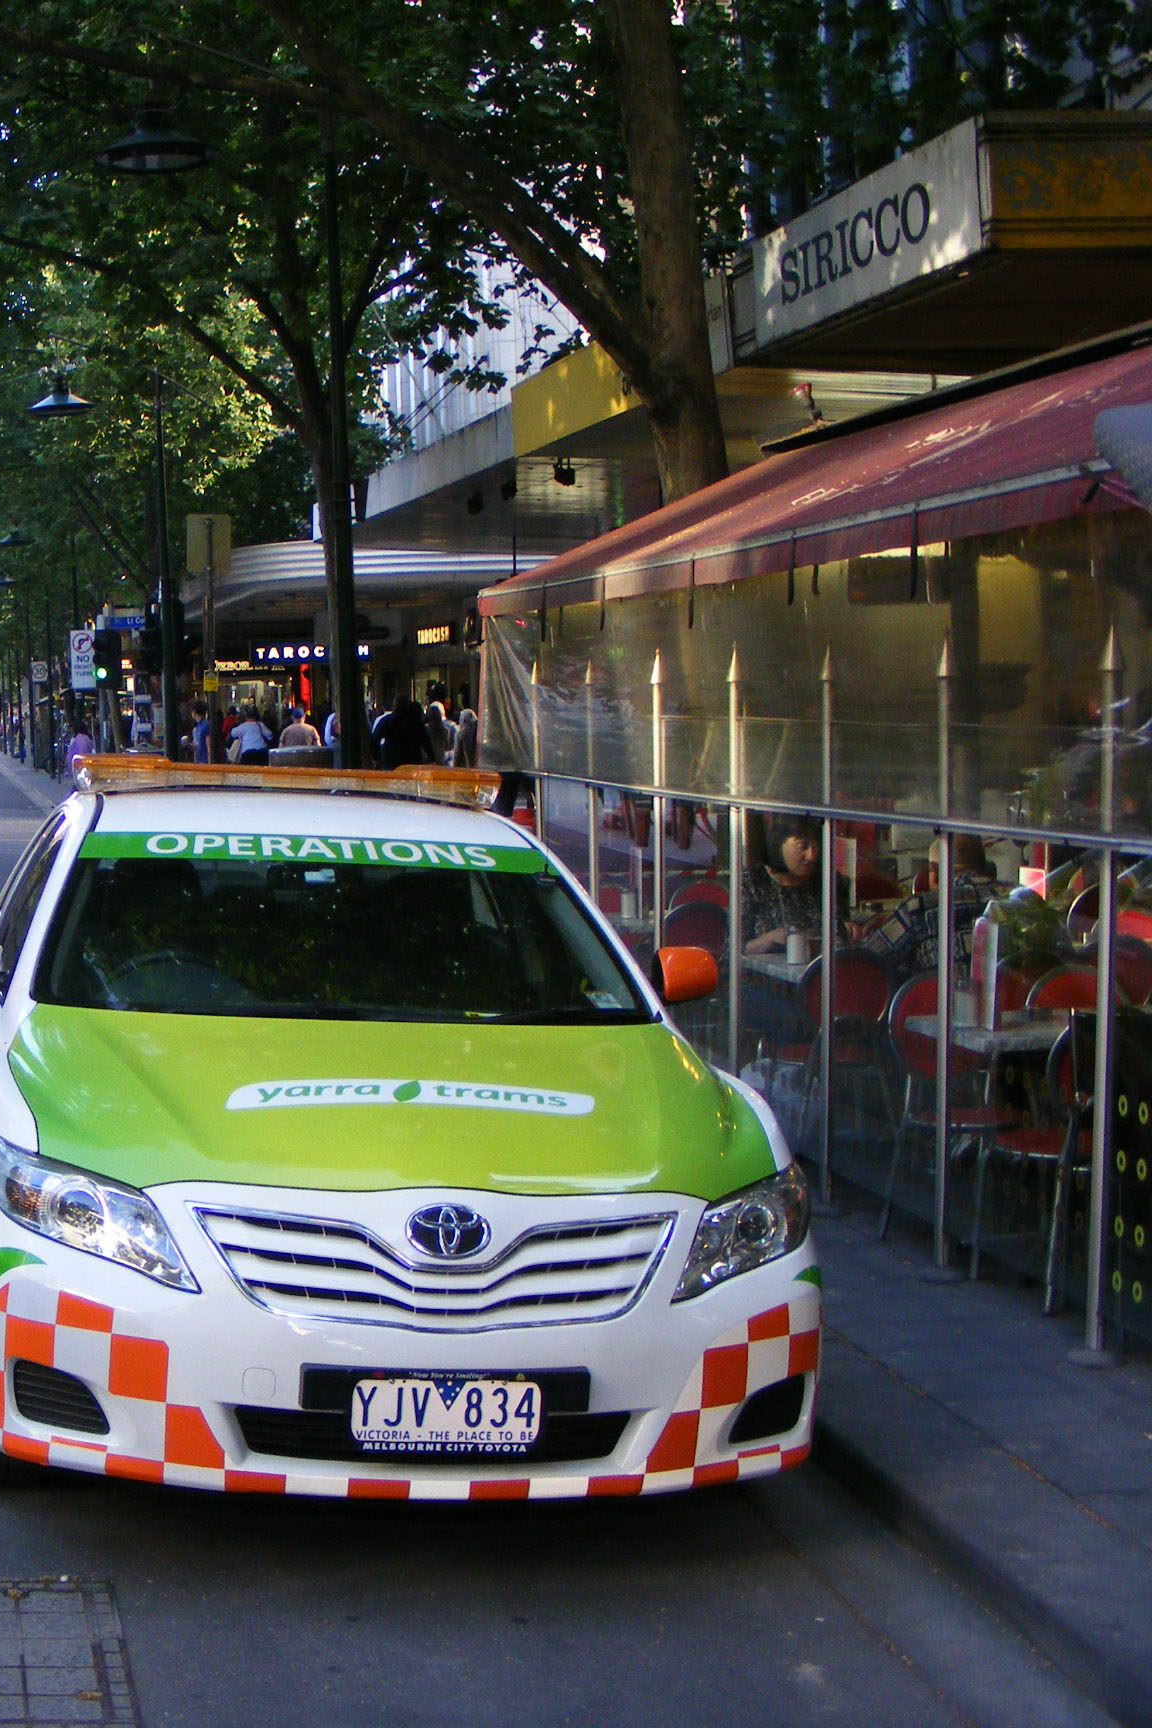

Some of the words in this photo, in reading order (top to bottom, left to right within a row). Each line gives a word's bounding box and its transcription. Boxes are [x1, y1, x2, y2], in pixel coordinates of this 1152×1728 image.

[780, 182, 930, 306] SIRICCO
[76, 655, 90, 663] NO
[255, 644, 370, 661] TAROCH
[146, 833, 497, 868] OPERATIONS
[256, 1083, 380, 1103] yarra
[433, 1083, 568, 1108] trams
[355, 1385, 432, 1428] YJV
[464, 1386, 535, 1428] 834
[355, 1429, 411, 1441] VICTORIA
[429, 1430, 450, 1441] THE
[456, 1431, 492, 1441] PLACE
[498, 1431, 513, 1441] TO
[519, 1431, 534, 1441] BE
[362, 1441, 442, 1452] MELBOURNE
[446, 1442, 475, 1453] CITY
[476, 1443, 527, 1453] TOYOTA
